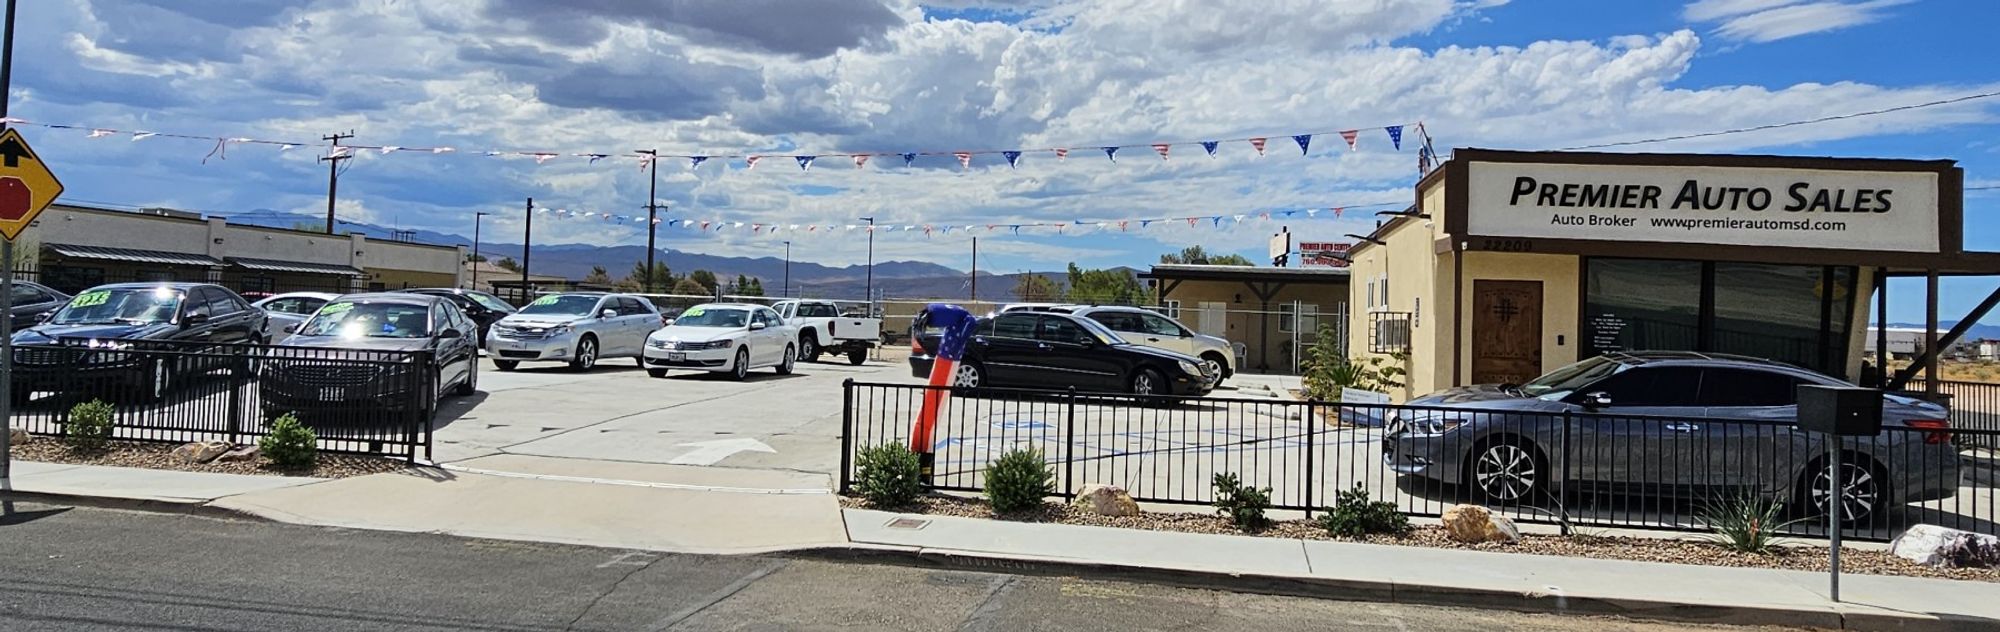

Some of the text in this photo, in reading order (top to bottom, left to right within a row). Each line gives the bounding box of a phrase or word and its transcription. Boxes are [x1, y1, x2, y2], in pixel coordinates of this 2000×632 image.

[1551, 213, 1847, 231] Auto Broker www.premierautomsd.com
[1483, 239, 1533, 251] 22209
